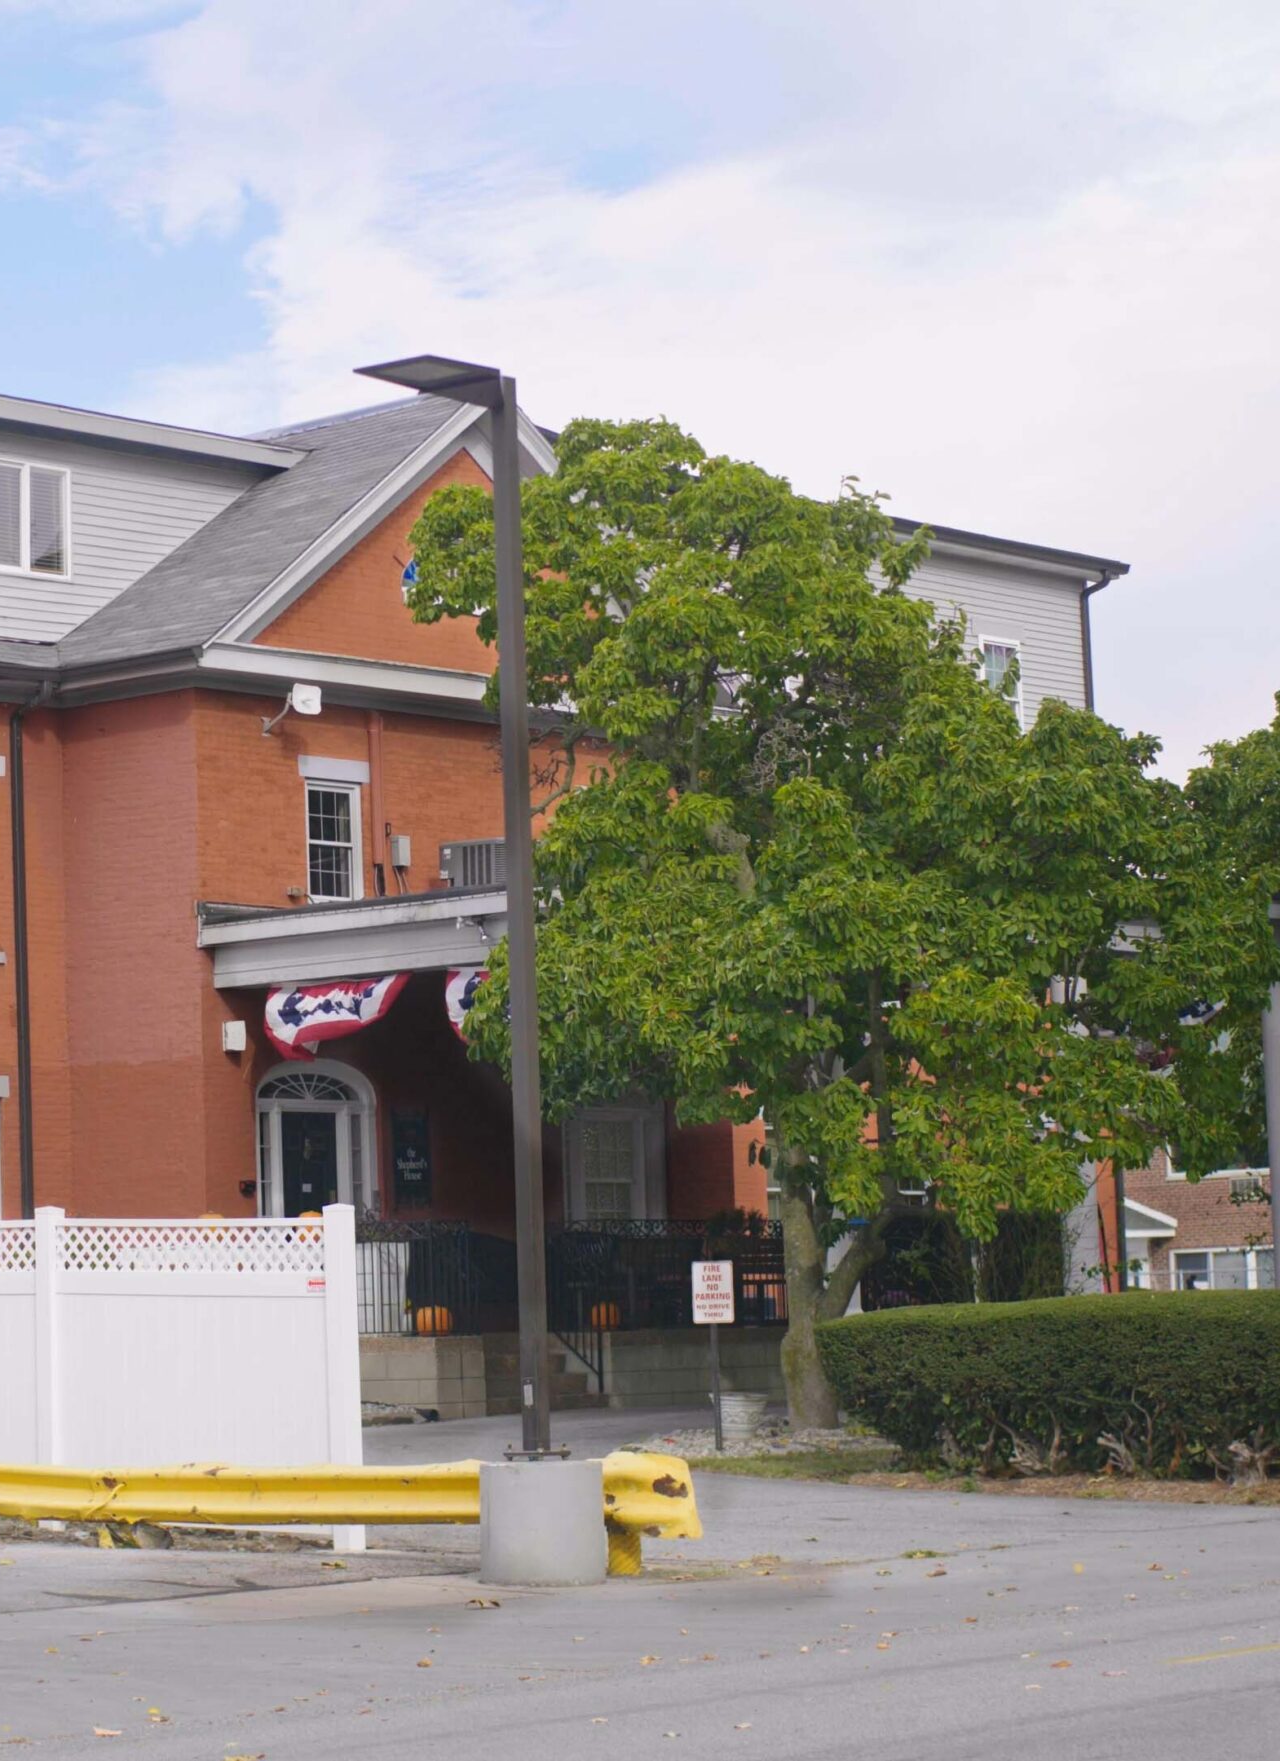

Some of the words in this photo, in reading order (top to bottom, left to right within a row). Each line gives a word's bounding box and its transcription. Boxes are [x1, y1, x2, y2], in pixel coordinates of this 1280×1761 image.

[703, 1265, 721, 1273] FIRE
[701, 1274, 723, 1283] LANE
[706, 1283, 719, 1291] NO
[695, 1292, 731, 1301] PARKING
